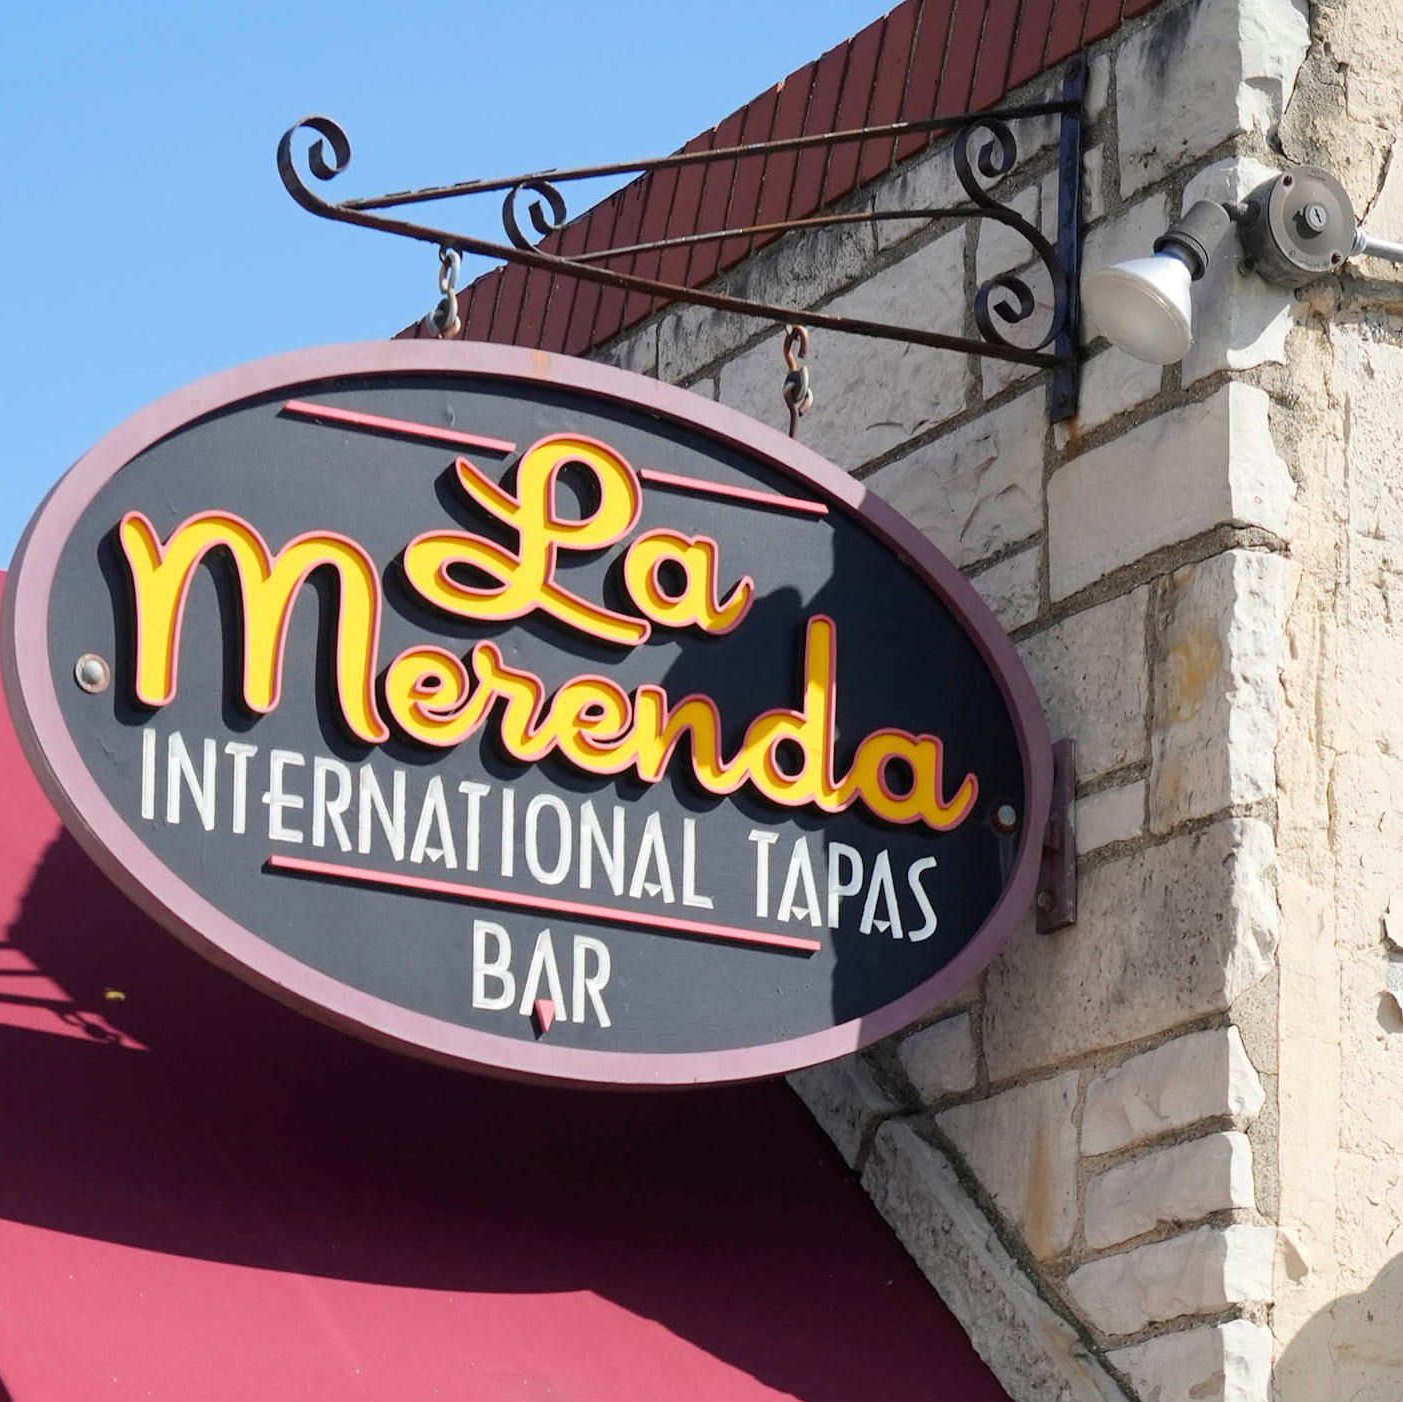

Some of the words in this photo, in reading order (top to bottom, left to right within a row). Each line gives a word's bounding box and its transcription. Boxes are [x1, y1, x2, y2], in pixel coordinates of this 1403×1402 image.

[404, 432, 755, 646] La
[119, 510, 978, 831] Merenda
[141, 728, 714, 909] INTERNATIONAL
[748, 829, 939, 943] TAPAS
[471, 918, 612, 1030] BAR
